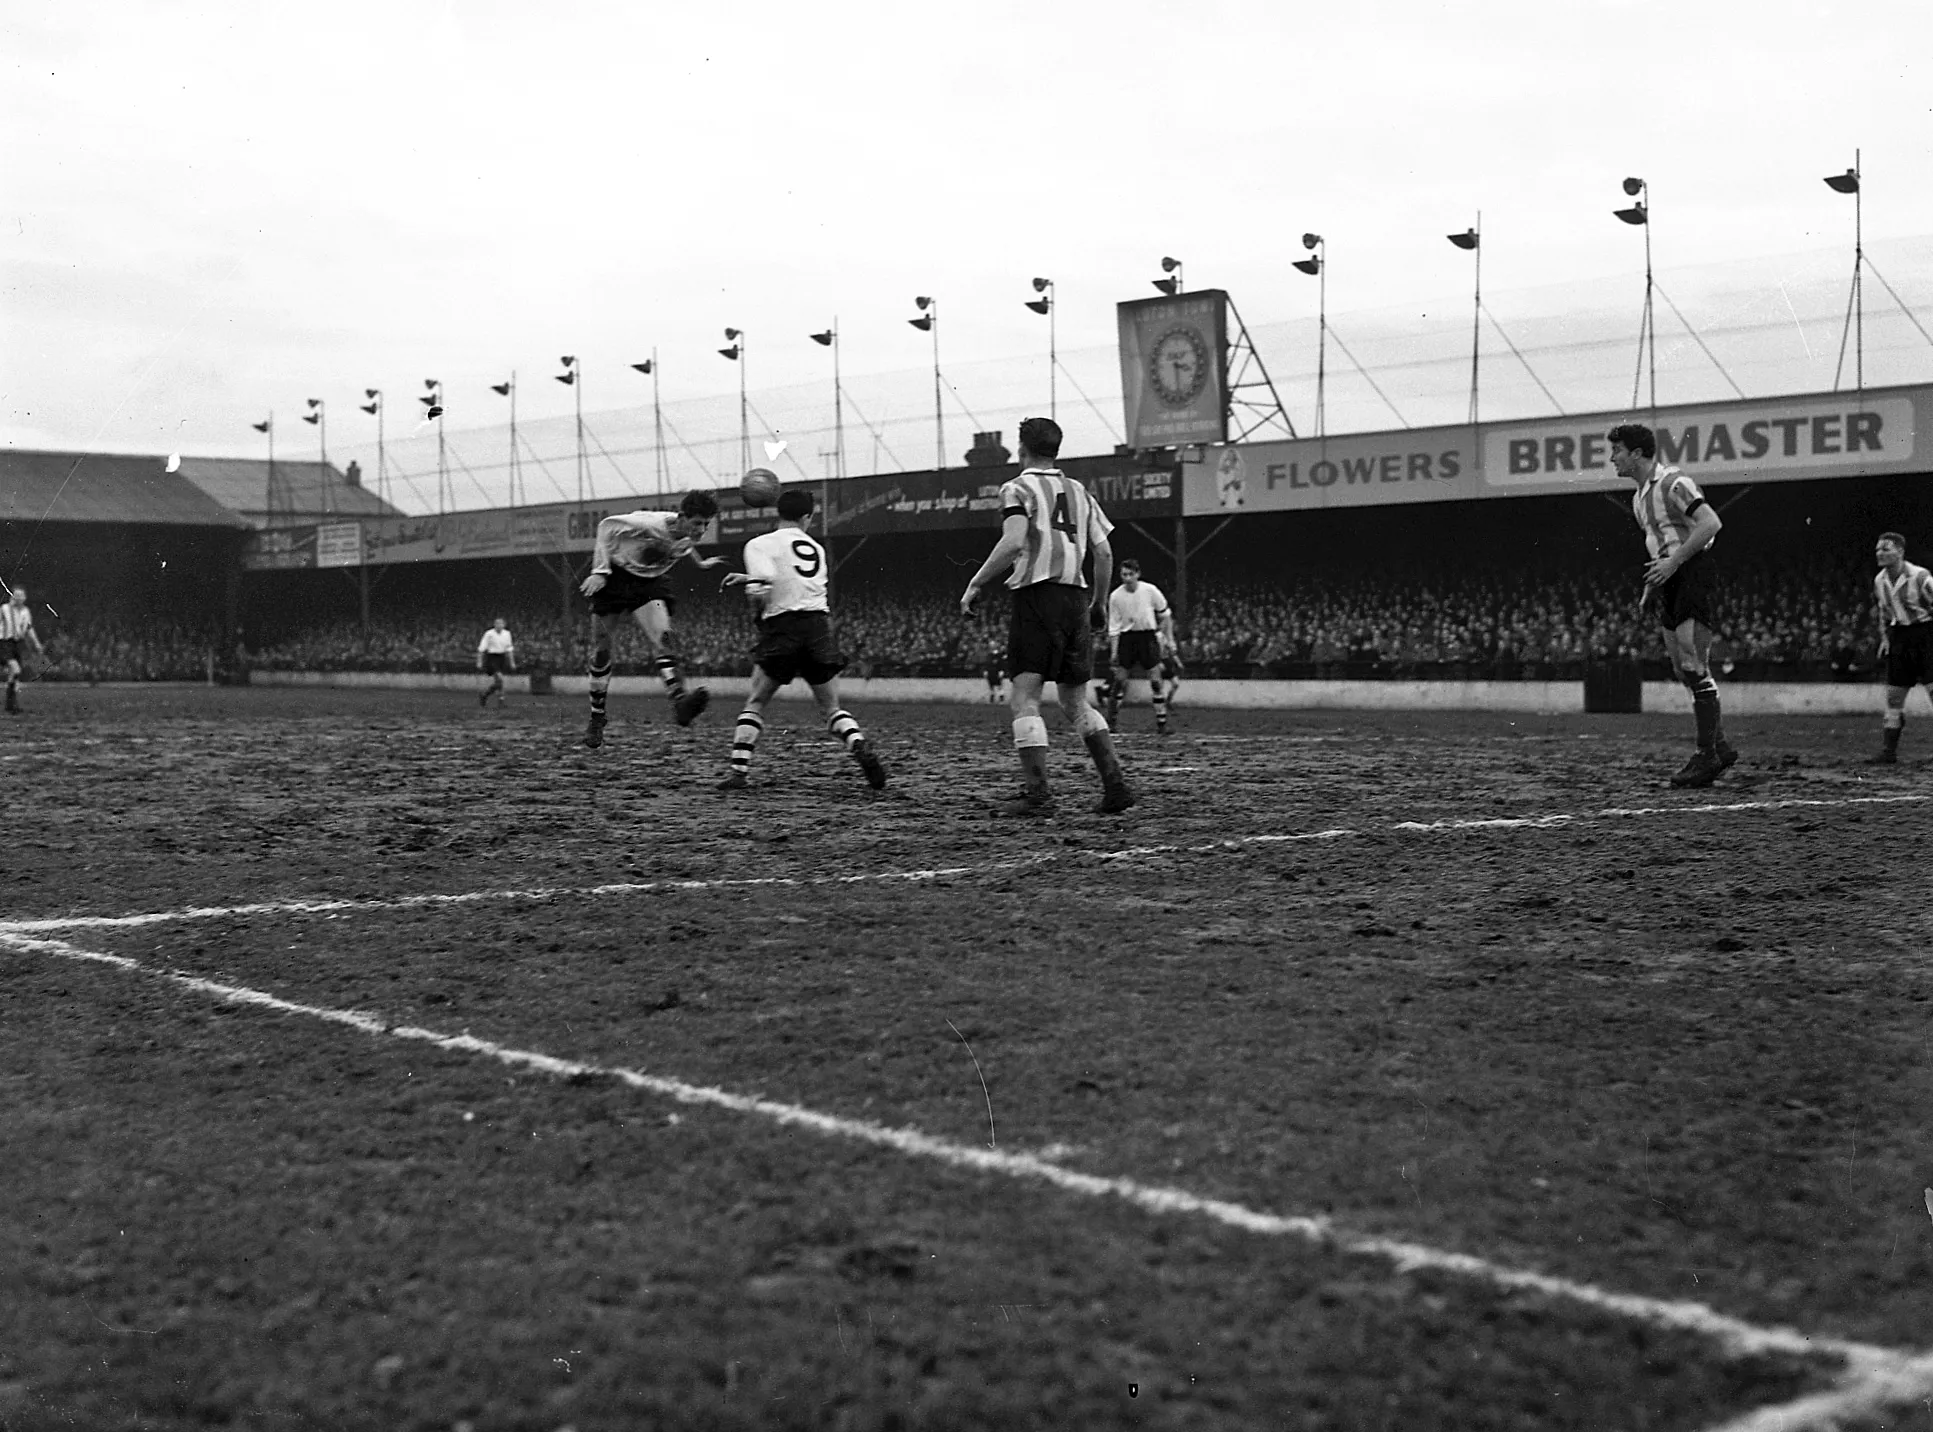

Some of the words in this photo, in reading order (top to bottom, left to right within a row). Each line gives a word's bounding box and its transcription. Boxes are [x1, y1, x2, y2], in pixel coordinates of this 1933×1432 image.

[1508, 411, 1884, 475] BREMASTER
[1087, 475, 1142, 501] ATIVE
[1265, 449, 1461, 491] FLOWERS
[1050, 492, 1078, 545] 4
[791, 539, 820, 578] 9
